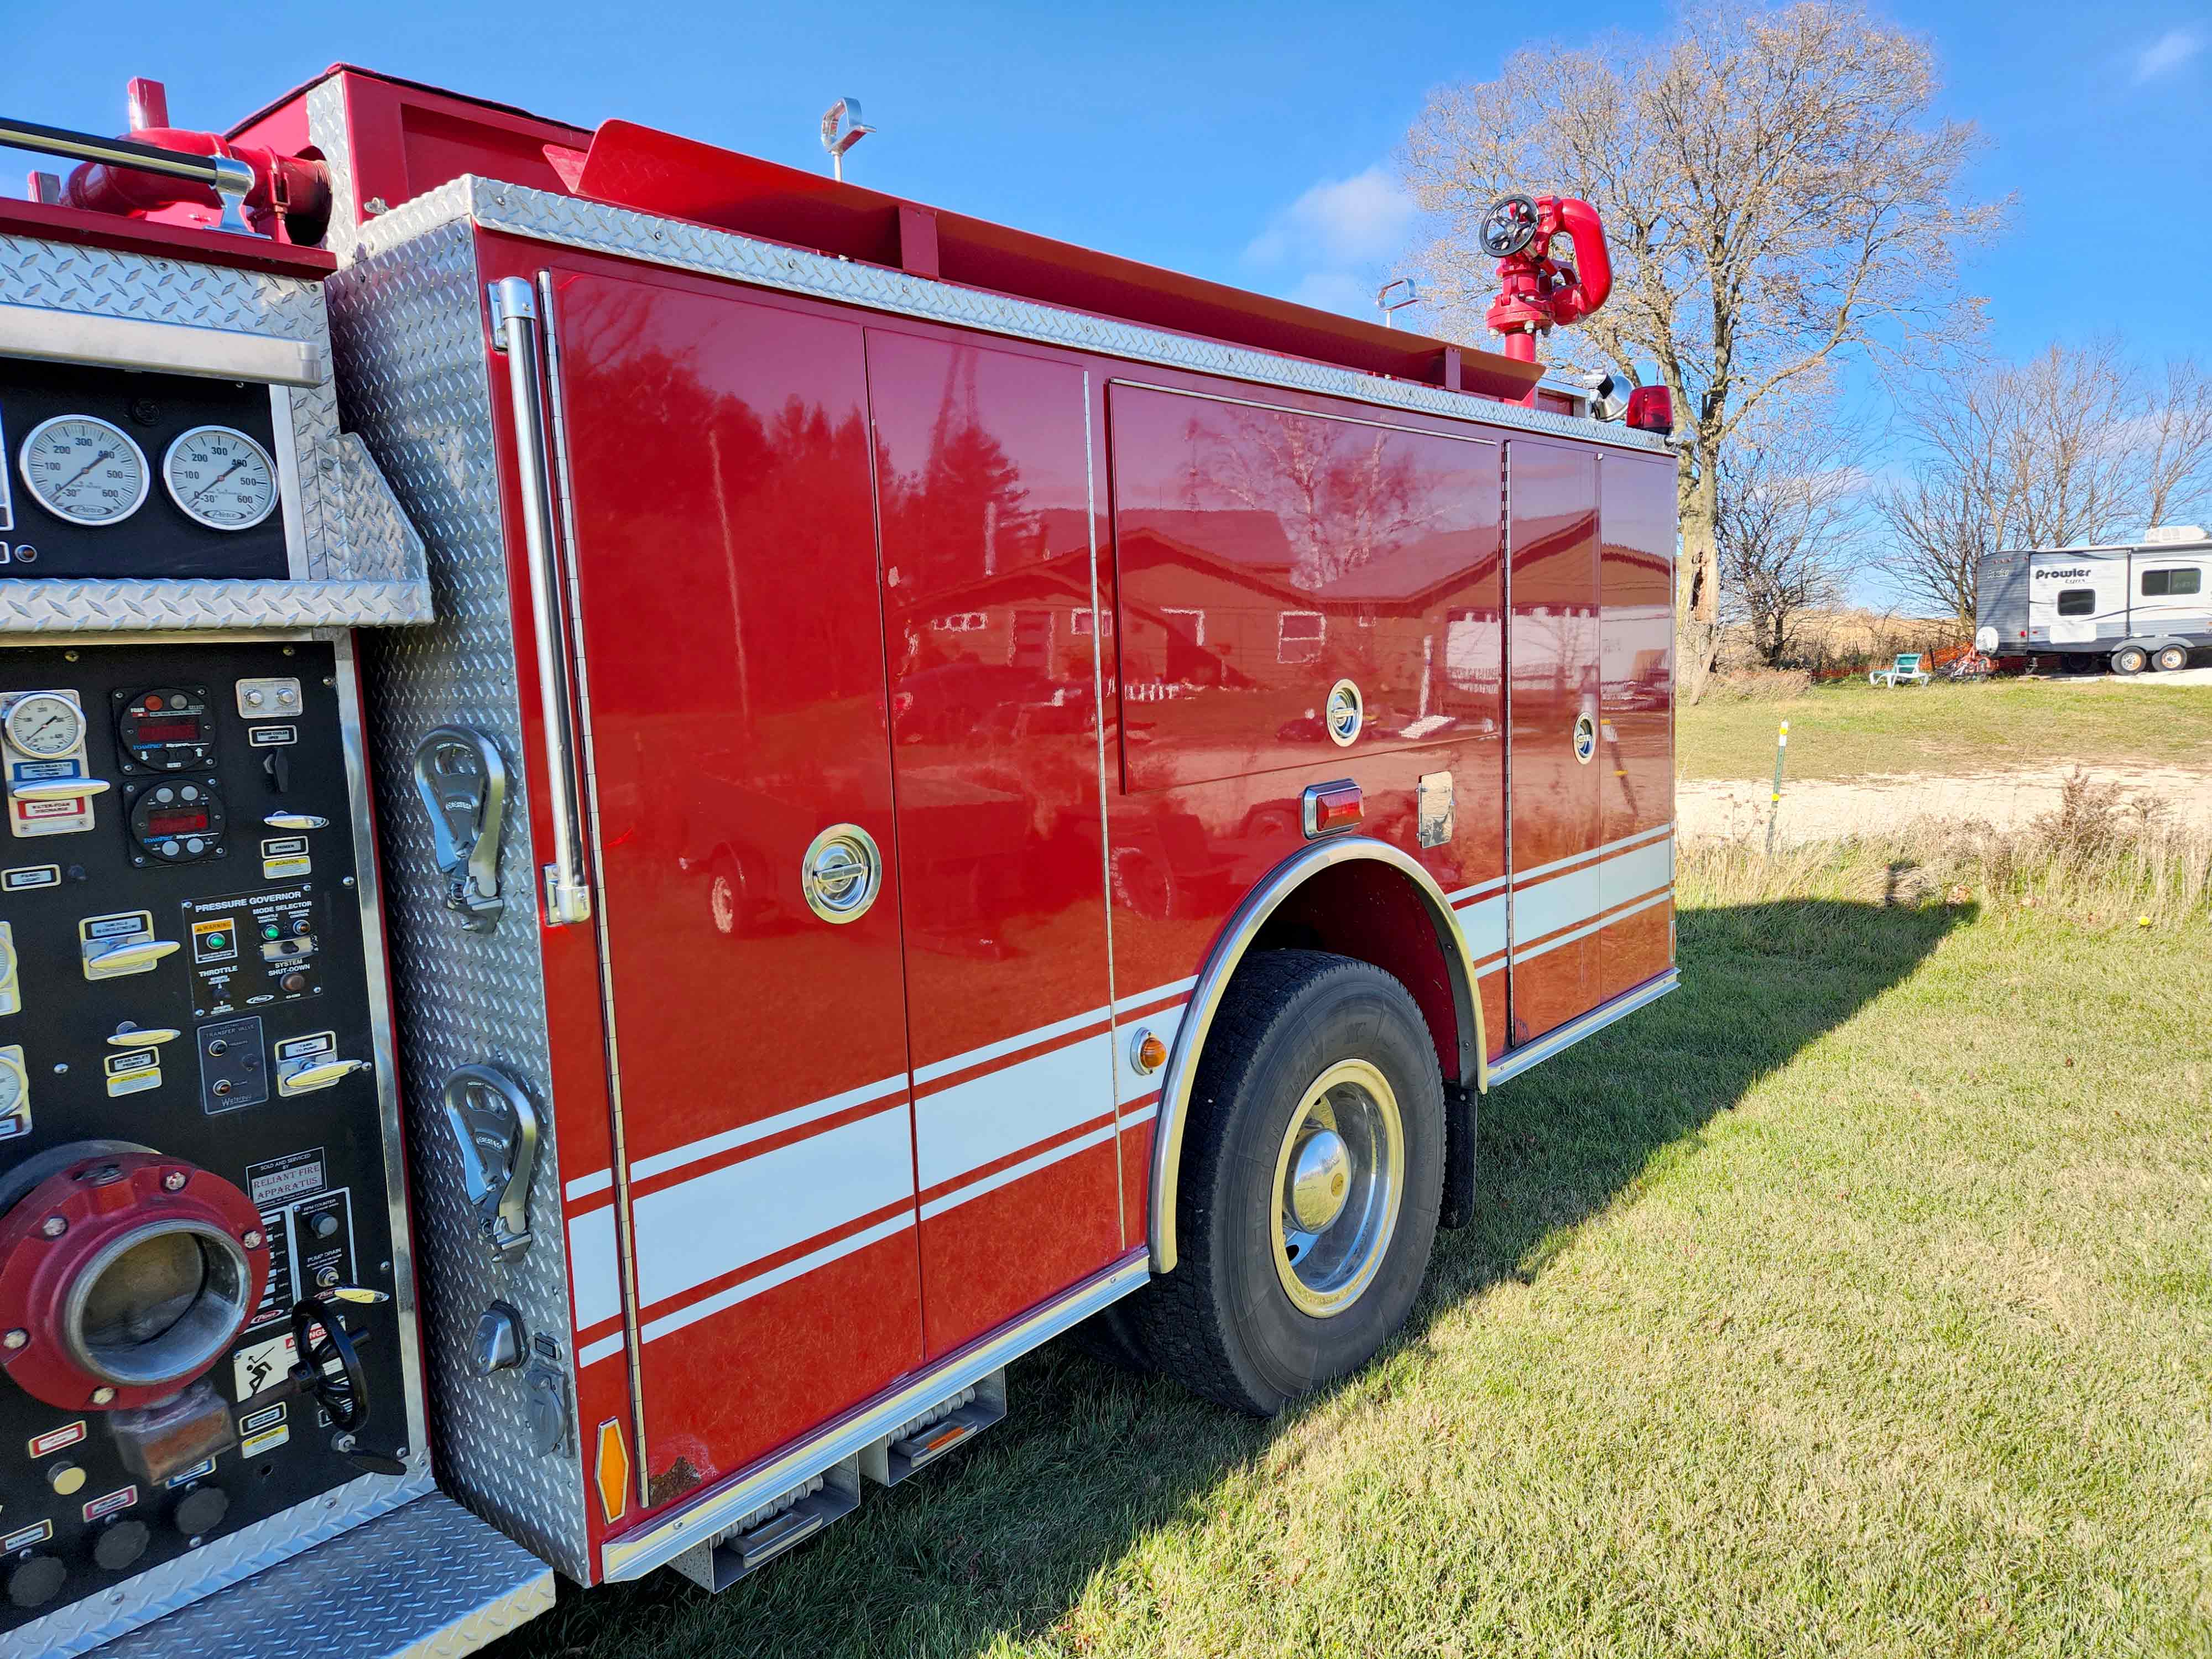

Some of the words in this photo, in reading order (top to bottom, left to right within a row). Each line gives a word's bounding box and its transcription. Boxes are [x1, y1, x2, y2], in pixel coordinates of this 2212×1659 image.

[75, 437, 92, 446] 300
[53, 445, 71, 454] 200
[211, 447, 228, 456] 300
[192, 453, 208, 462] 200
[45, 462, 61, 471] 100
[107, 470, 123, 478] 500
[185, 471, 200, 479] 100
[241, 478, 257, 486] 500
[2036, 568, 2091, 580] Prowler
[195, 898, 248, 913] PRESSURE
[249, 891, 301, 905] GOVERNOR
[253, 906, 274, 915] MODE
[275, 901, 312, 911] SELECTOR
[203, 921, 231, 930] WARNING
[275, 958, 302, 968] SYSTEM
[199, 965, 238, 977] THROTTLE
[268, 964, 310, 977] SHUT-DOWN
[206, 1029, 234, 1038] TRANSFER
[288, 1153, 311, 1164] SERVICED
[254, 1171, 296, 1188] RELIANT
[299, 1165, 320, 1176] FIRE
[257, 1177, 317, 1199] APPARATUS
[314, 1199, 336, 1208] COUNTER
[307, 1254, 324, 1262] PUMP
[324, 1248, 341, 1258] DRAIN
